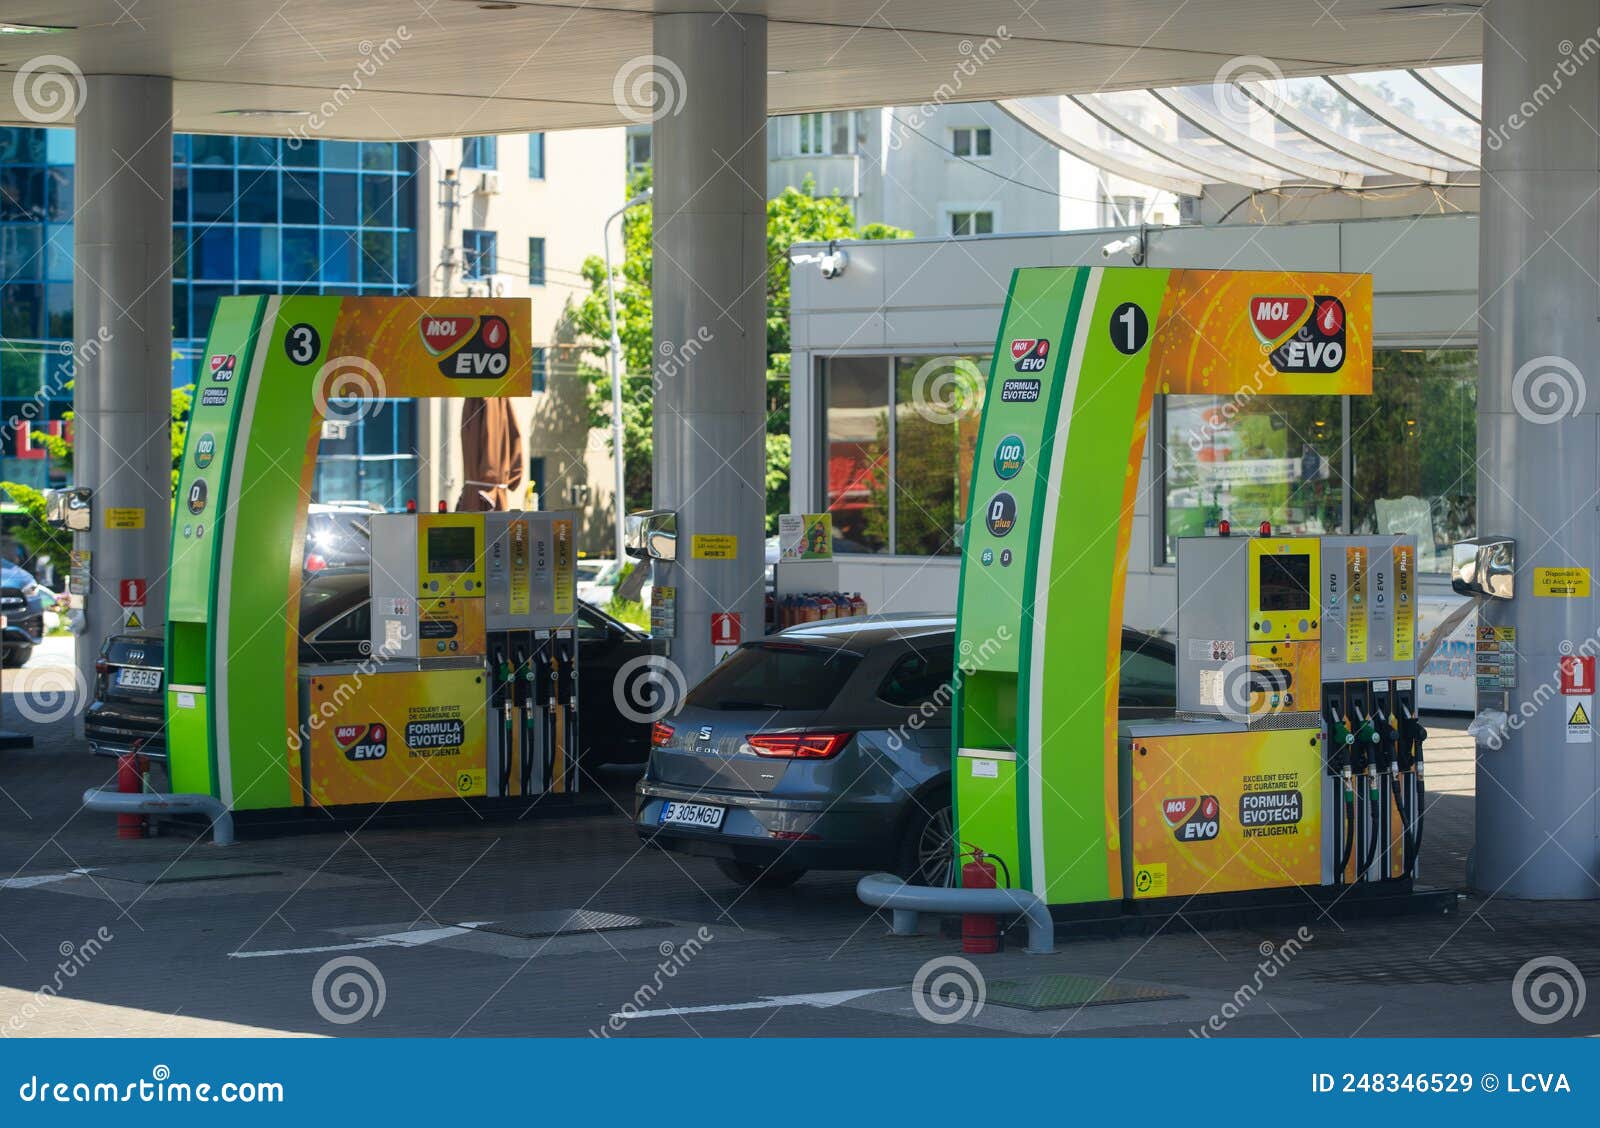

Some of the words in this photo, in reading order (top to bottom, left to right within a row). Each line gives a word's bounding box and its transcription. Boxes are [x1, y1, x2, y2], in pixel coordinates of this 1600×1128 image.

[1256, 302, 1289, 320] MOL
[426, 321, 457, 336] MOL
[1120, 307, 1135, 349] 1
[293, 327, 313, 362] 3
[1012, 342, 1028, 351] MOL
[1287, 342, 1343, 368] EVO
[455, 353, 508, 375] EVO
[1021, 359, 1045, 370] EVO
[216, 370, 232, 380] EVO
[1004, 381, 1039, 390] FORMULA
[1002, 391, 1038, 400] EVOTECH
[1000, 445, 1019, 460] 100
[1002, 460, 1019, 471] plus
[191, 486, 199, 501] D
[991, 501, 1003, 520] D
[994, 518, 1011, 529] plus
[338, 726, 356, 738] MOL
[409, 721, 460, 735] FORMULA
[409, 733, 461, 746] EVOTECH
[354, 744, 386, 759] EVO
[1243, 774, 1276, 783] EXCELENT
[1278, 772, 1298, 781] EFECT
[1166, 801, 1186, 813] MOL
[1243, 794, 1298, 809] FORMULA
[666, 804, 676, 819] B
[1243, 807, 1298, 823] EVOTECH
[1184, 821, 1218, 839] EVO
